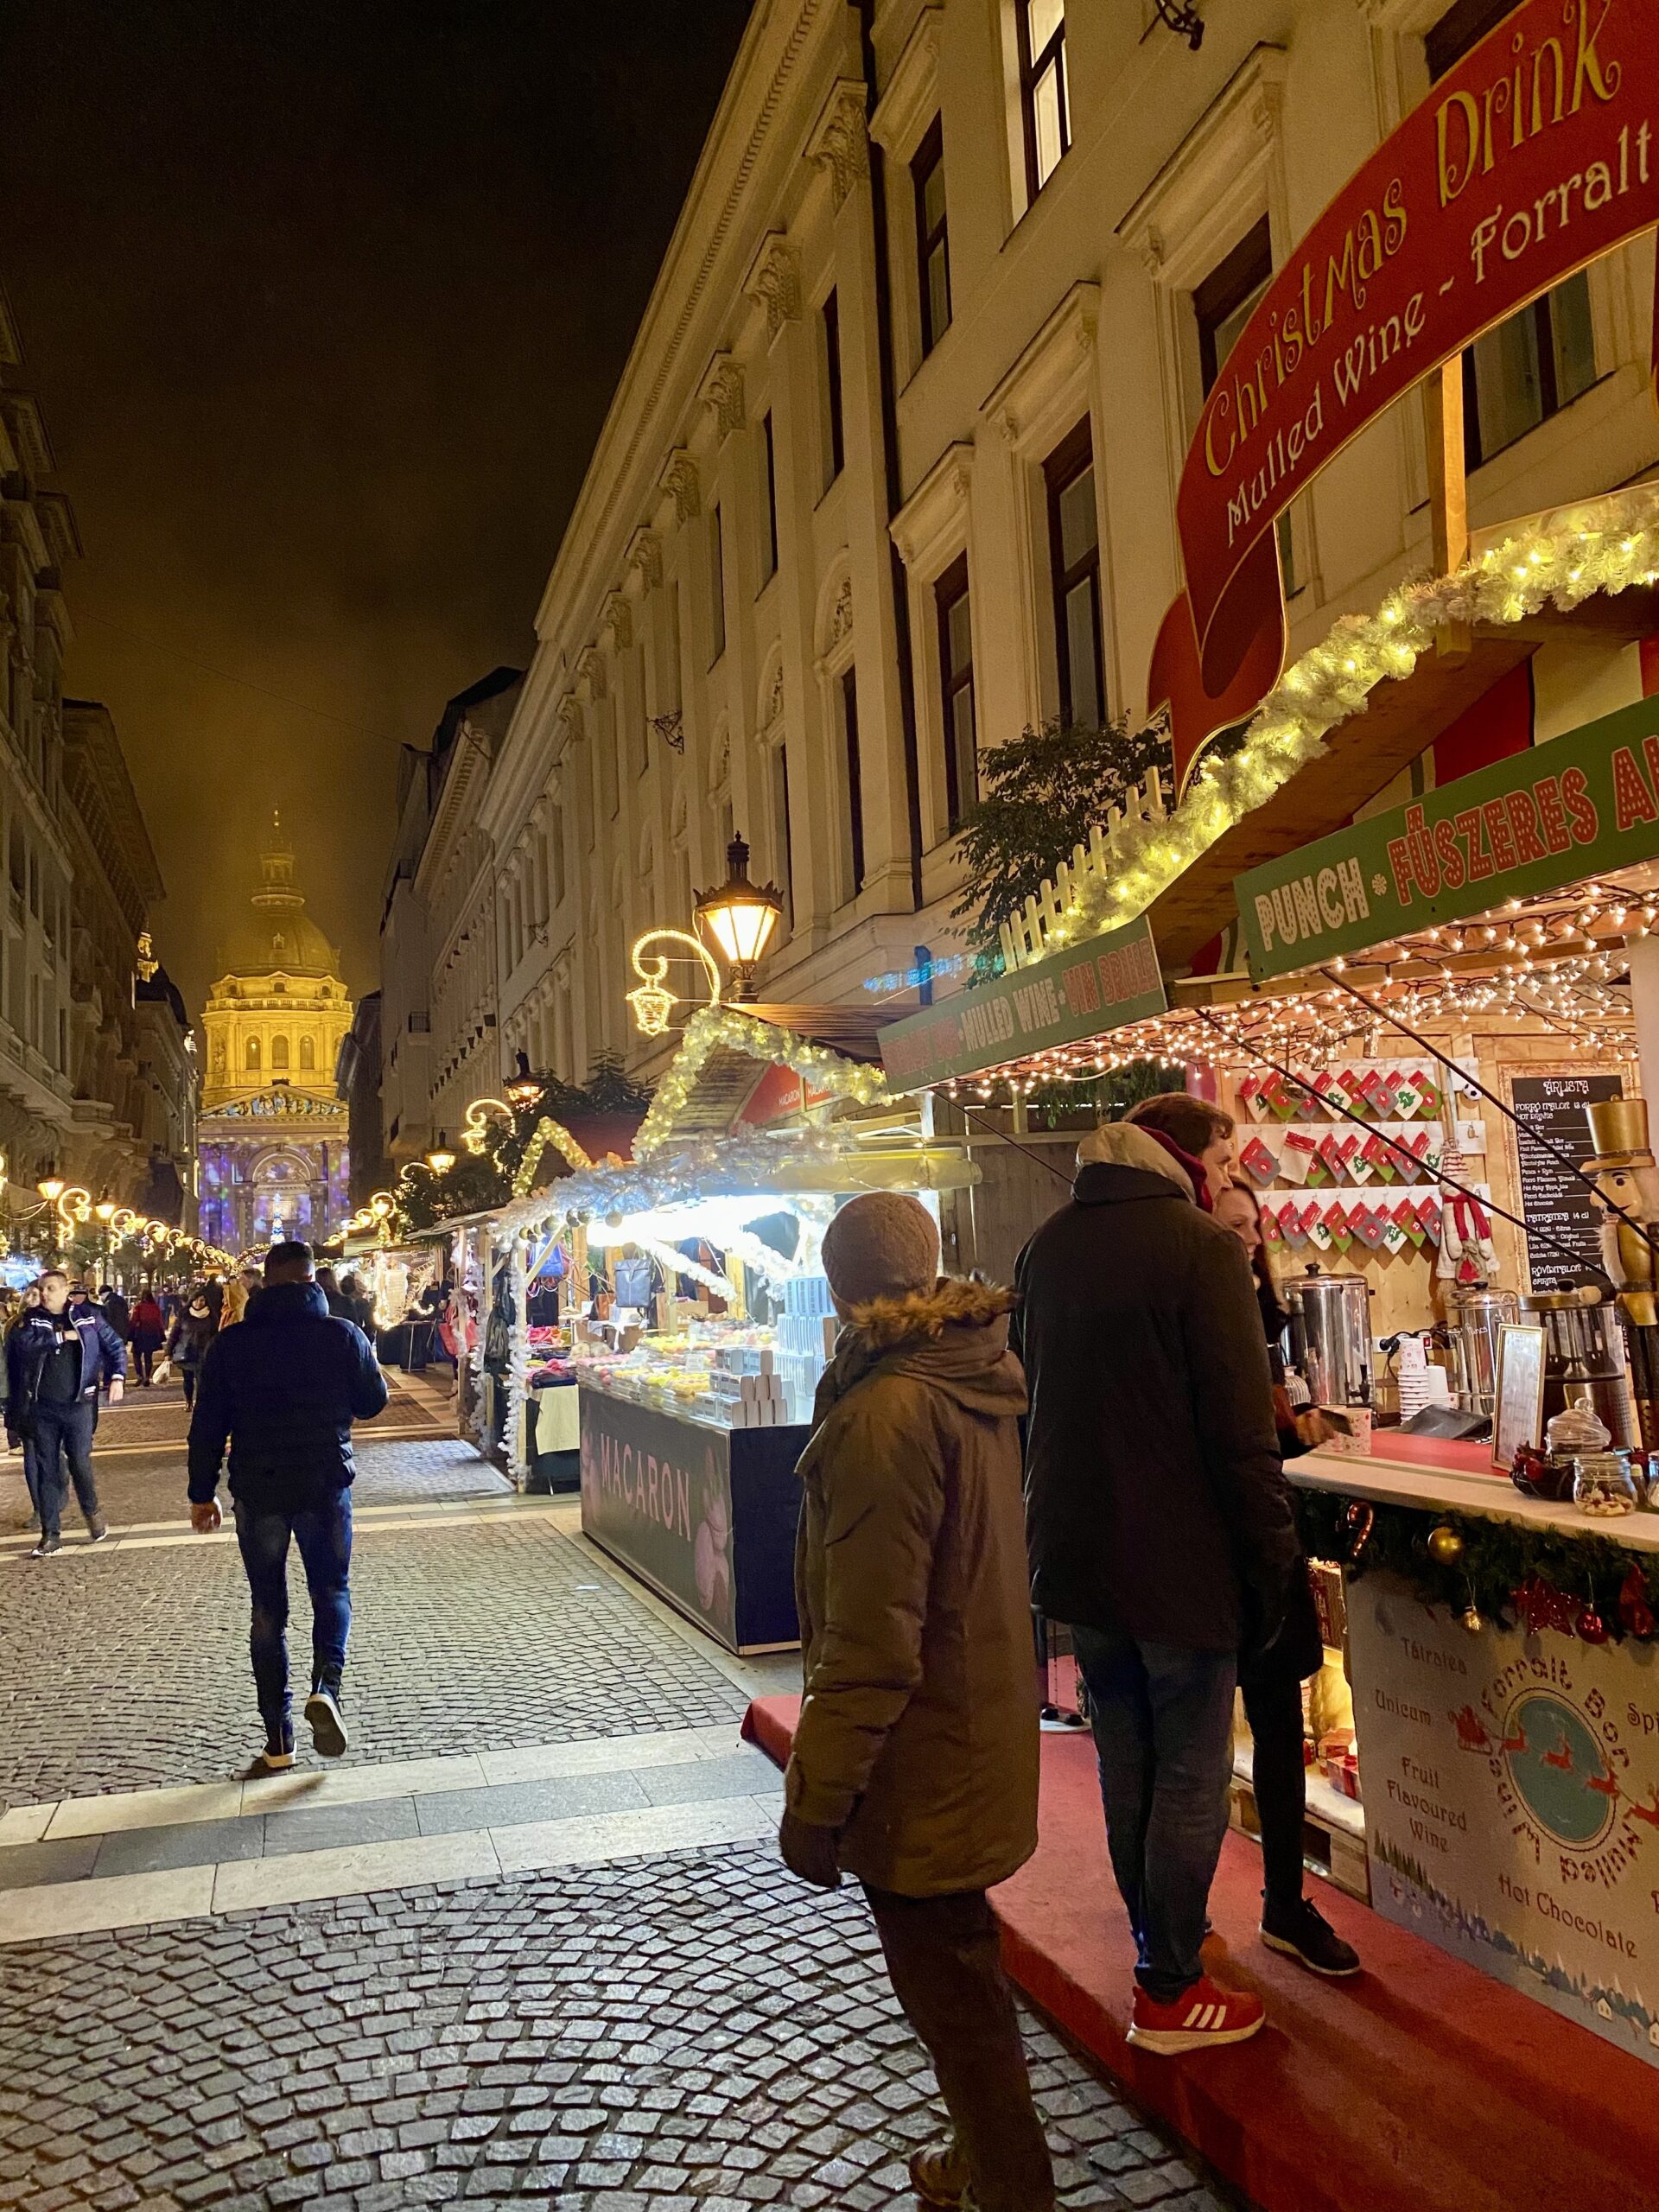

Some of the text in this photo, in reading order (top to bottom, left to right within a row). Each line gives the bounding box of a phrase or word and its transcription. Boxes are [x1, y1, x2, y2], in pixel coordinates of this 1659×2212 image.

[1205, 178, 1408, 476] Christmas
[1227, 379, 1323, 549] Mulled
[1333, 290, 1427, 408] Wine
[1471, 118, 1652, 283] Forralt
[1254, 857, 1370, 952] PUNCH
[1387, 803, 1599, 907] FŰSZERES
[1013, 976, 1060, 1033] WINE
[1543, 1078, 1590, 1097] ÁRLISTA
[601, 1433, 691, 1542] MACARON
[1481, 1655, 1630, 1768] Forralt Bor
[1387, 1779, 1467, 1832] Flavoured
[1402, 1757, 1440, 1789] Fruit
[1409, 1817, 1449, 1853] Wine
[1559, 1821, 1643, 1890] Mulled
[1498, 1873, 1530, 1906] Hot
[1537, 1892, 1637, 1958] Chocolate
